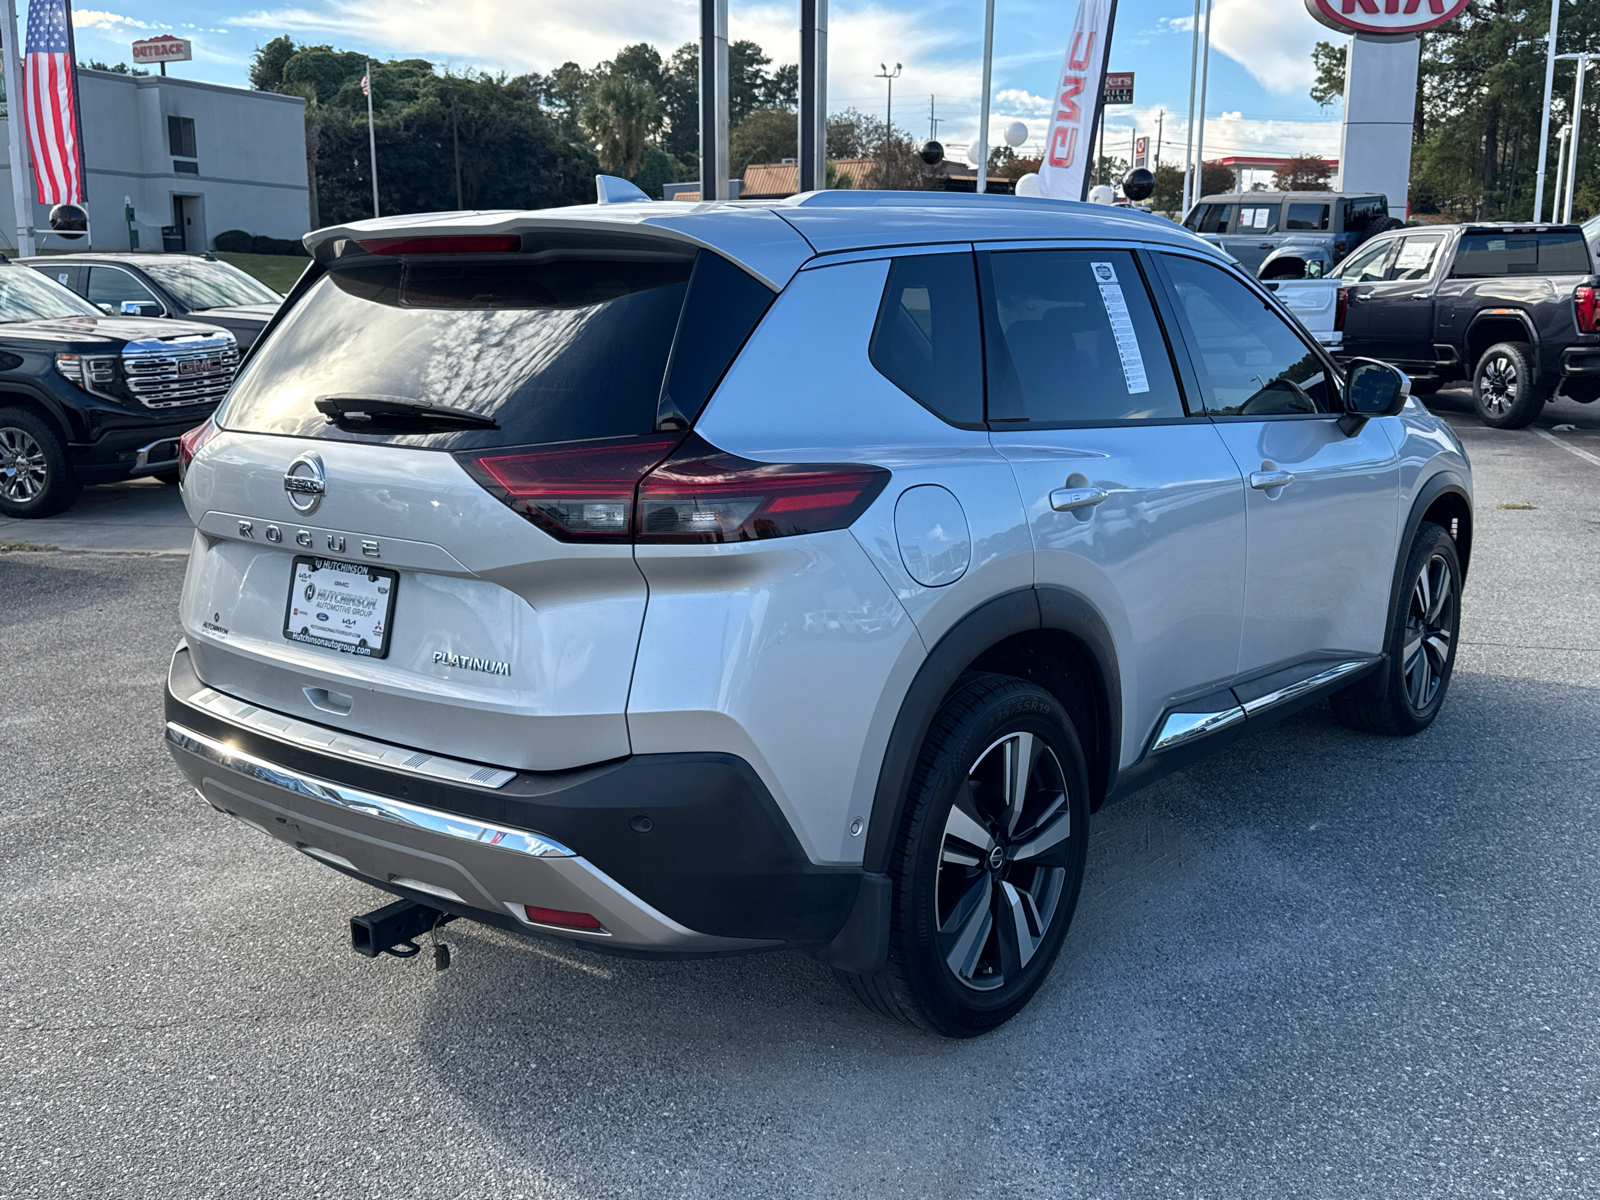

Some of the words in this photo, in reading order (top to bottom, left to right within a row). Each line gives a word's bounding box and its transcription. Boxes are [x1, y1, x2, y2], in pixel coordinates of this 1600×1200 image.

[132, 43, 183, 58] OUTBACK
[180, 358, 221, 374] GMC
[285, 477, 321, 493] NISSAN
[238, 520, 380, 558] ROGUE
[322, 560, 369, 576] HUTCHINSON
[316, 588, 378, 610] HUTCHINSON
[316, 601, 351, 614] AUTOMOTIVE
[352, 607, 373, 618] GROUP
[292, 631, 371, 656] Hutchinsonautogroup.com
[432, 651, 511, 676] PLATINUM
[987, 700, 1051, 732] 235/55R19
